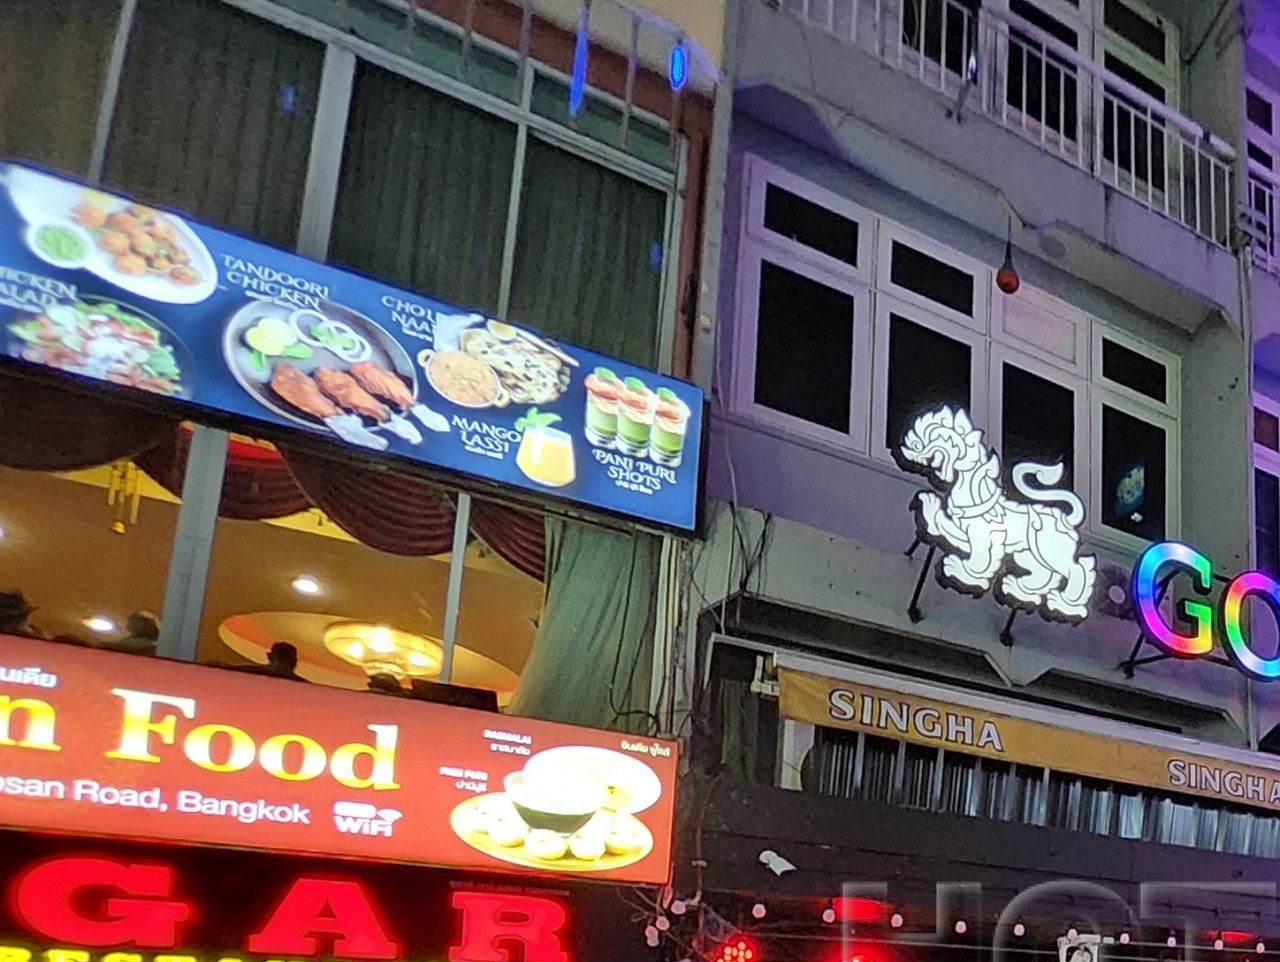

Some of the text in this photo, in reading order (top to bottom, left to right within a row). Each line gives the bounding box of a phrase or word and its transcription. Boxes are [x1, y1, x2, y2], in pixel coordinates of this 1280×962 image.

[221, 253, 329, 300] TANDOORI
[226, 271, 323, 312] CHICKEN
[452, 415, 522, 443] MANGO
[460, 430, 509, 453] LASSI
[592, 449, 677, 484] PANI PURI
[607, 465, 662, 490] SHOTS
[105, 687, 401, 792] Food
[828, 688, 1005, 752] SINGHA
[73, 778, 168, 813] Road,
[176, 789, 311, 825] Bangkok
